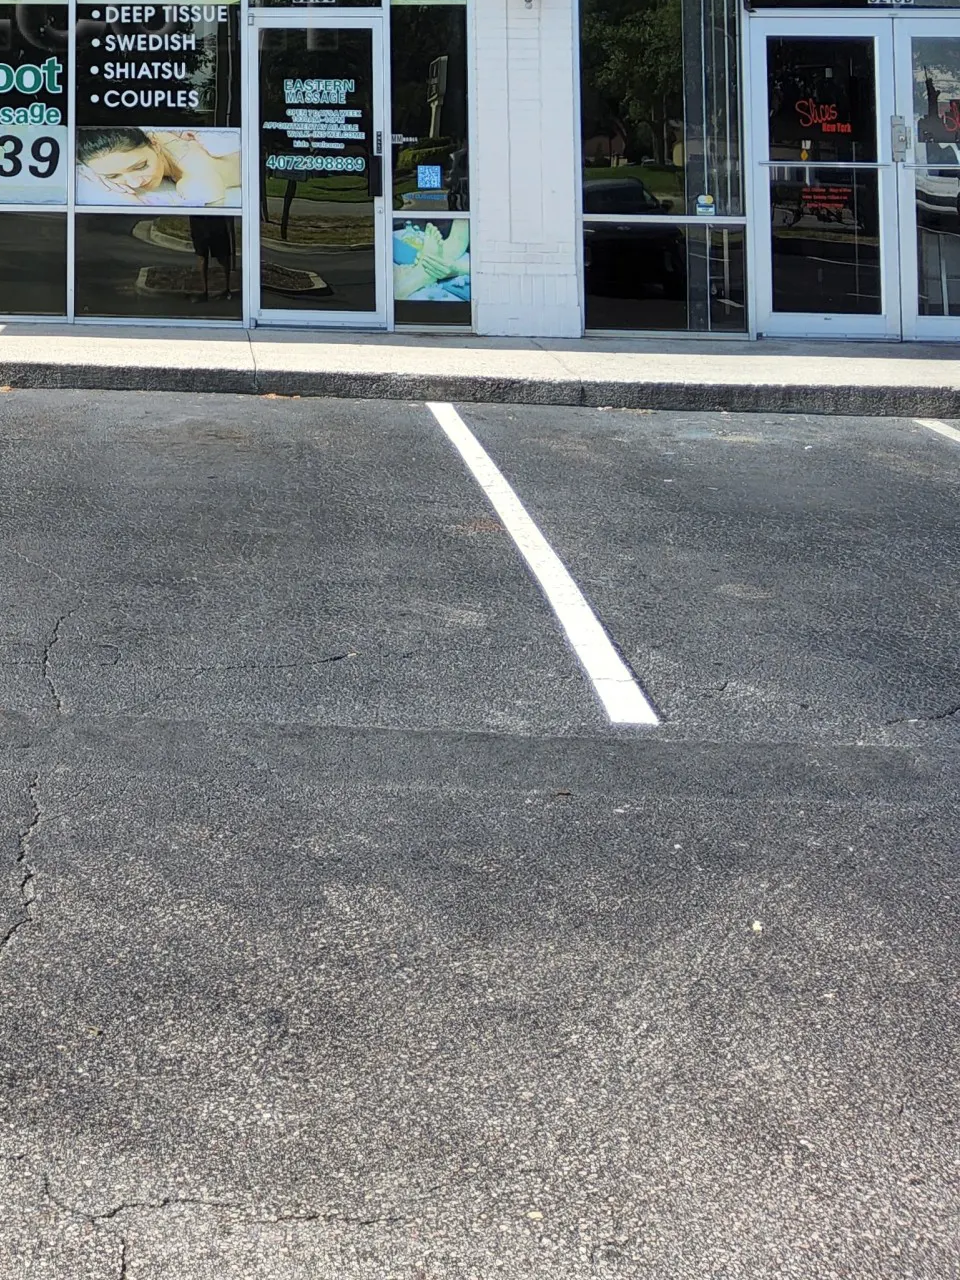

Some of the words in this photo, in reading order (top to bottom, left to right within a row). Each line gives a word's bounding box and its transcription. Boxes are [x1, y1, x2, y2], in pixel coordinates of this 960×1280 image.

[105, 6, 156, 23] DEEP
[162, 5, 227, 22] TISSUE
[105, 34, 196, 51] SWEDISH
[103, 62, 186, 80] SHIATSU
[283, 79, 355, 92] EASTERN
[104, 90, 199, 107] COUPLES
[285, 91, 346, 104] MASSAGE
[795, 98, 837, 126] Slices
[266, 155, 365, 171] 4072398889
